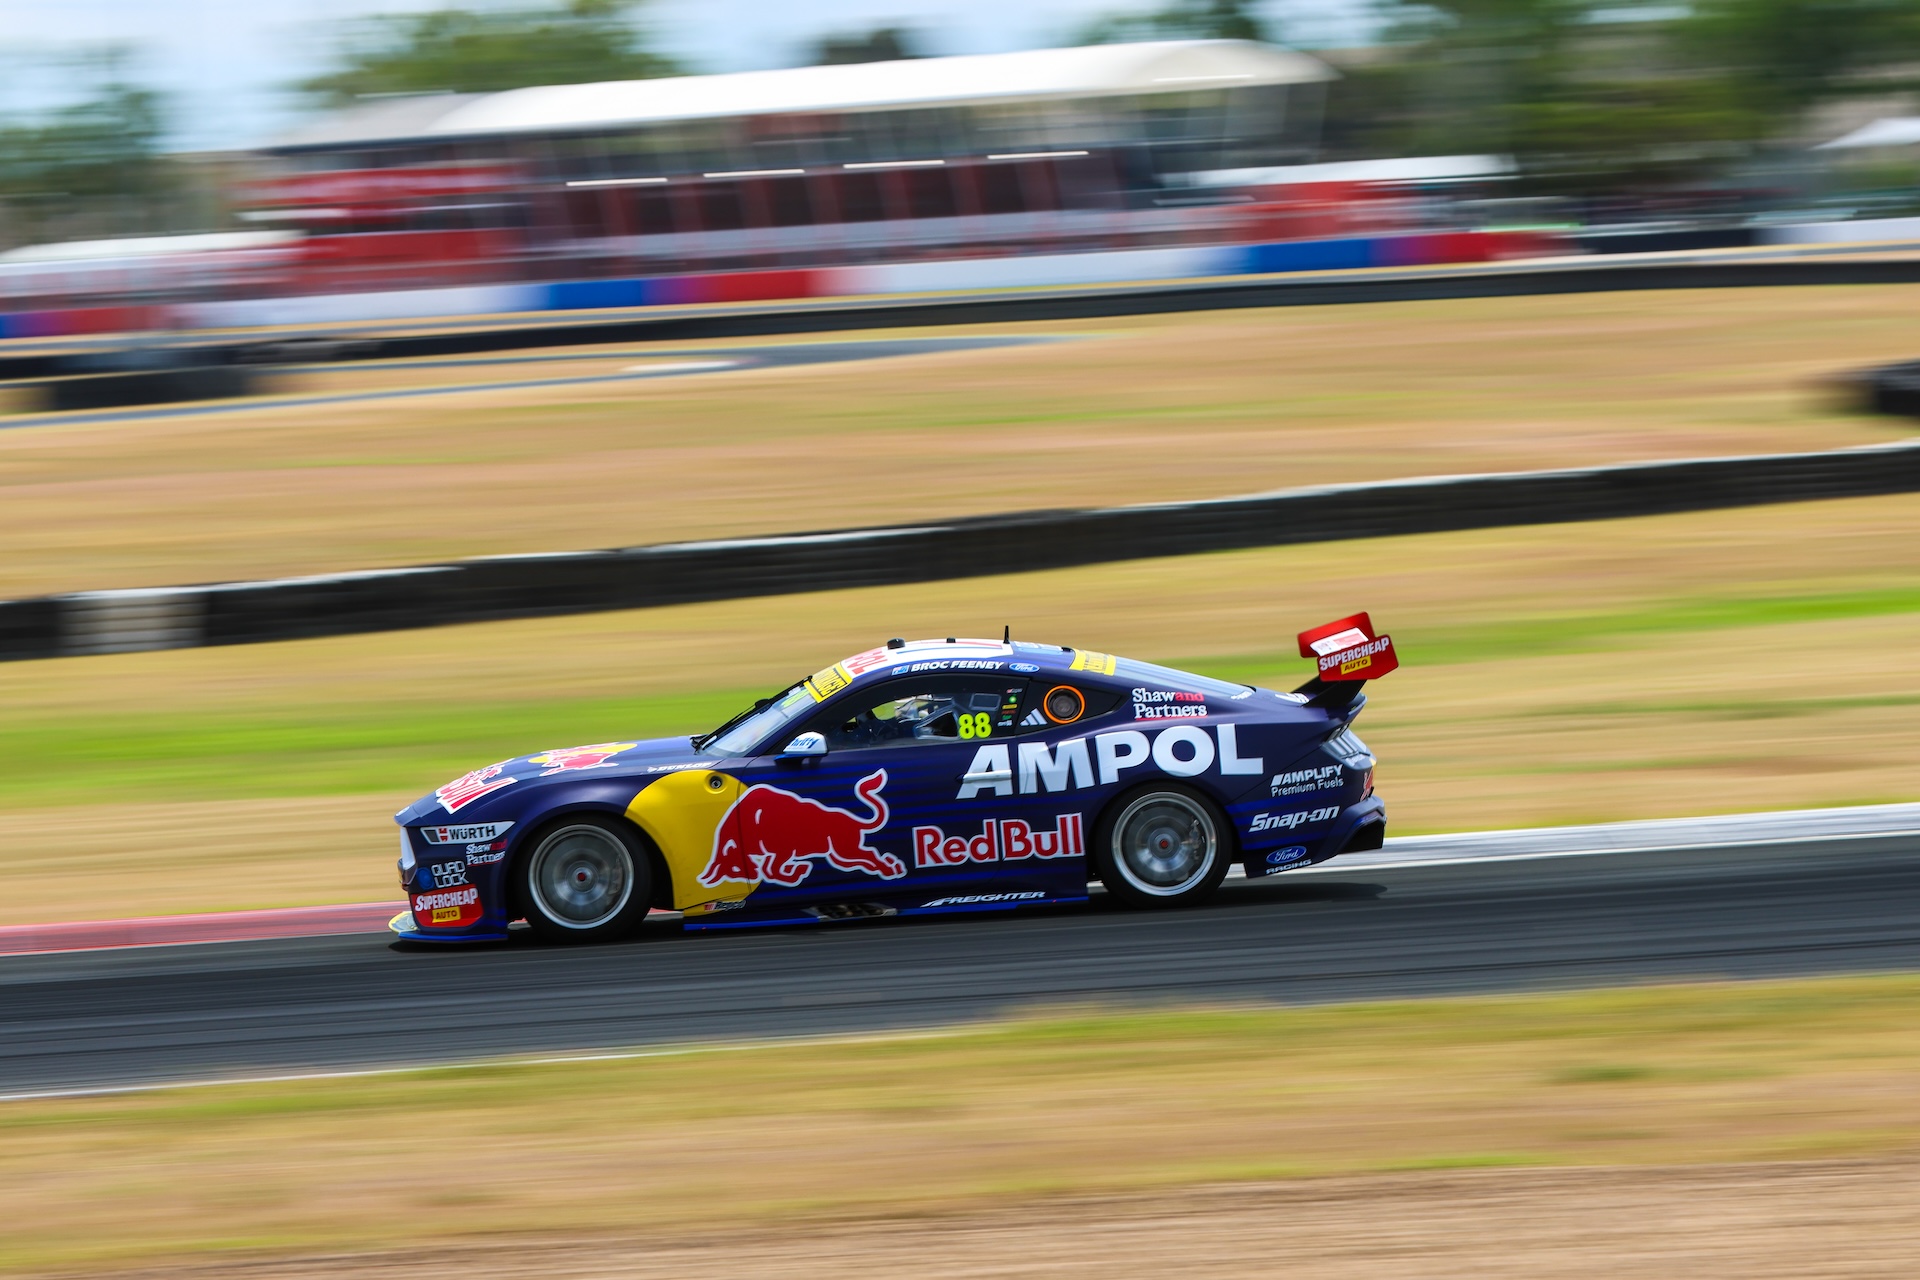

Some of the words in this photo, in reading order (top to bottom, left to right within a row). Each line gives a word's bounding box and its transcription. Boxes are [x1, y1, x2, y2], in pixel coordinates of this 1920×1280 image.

[1319, 637, 1389, 671] SUPERCHEAP
[911, 660, 949, 673] BROC
[950, 660, 1004, 671] FEENEY
[1343, 658, 1368, 672] AUTO
[1133, 703, 1208, 720] Partners
[957, 711, 993, 740] 88
[955, 723, 1264, 800] AMPOL
[1280, 764, 1343, 786] AMPLIFY
[1271, 782, 1316, 797] Premium
[1317, 776, 1344, 790] Fuels
[1248, 805, 1340, 833] Snap-on
[913, 818, 999, 868] Red
[1001, 812, 1085, 861] Bull
[431, 861, 466, 877] QUAD
[1266, 859, 1312, 875] RACING
[434, 872, 470, 888] LOCK
[414, 887, 479, 911] SUPERCHEAP
[929, 890, 1046, 907] FREIGHTER
[435, 909, 458, 920] AUTO
